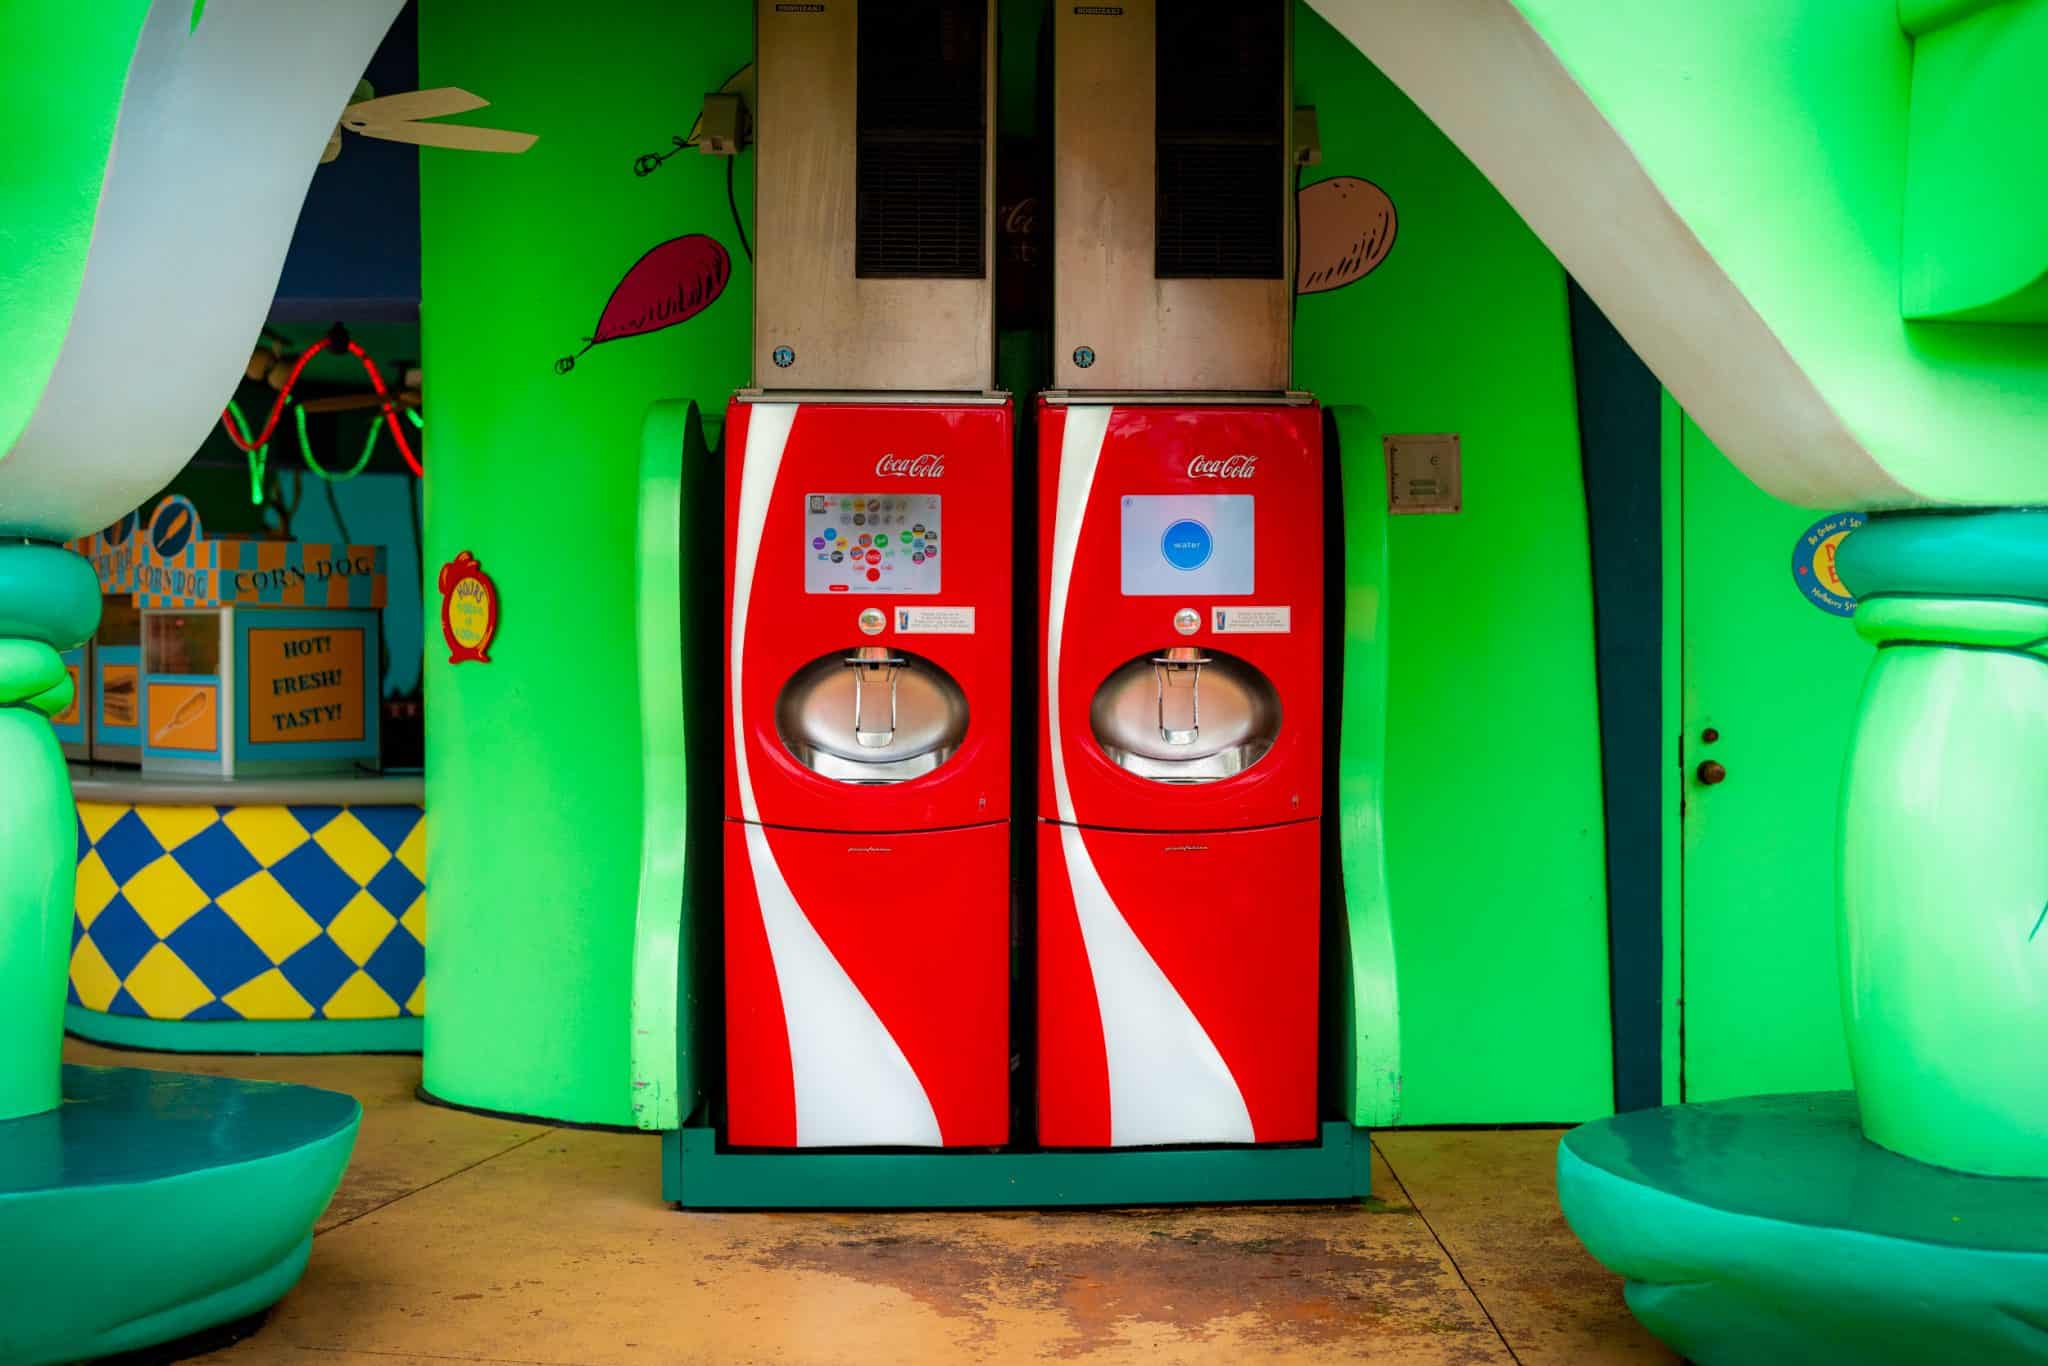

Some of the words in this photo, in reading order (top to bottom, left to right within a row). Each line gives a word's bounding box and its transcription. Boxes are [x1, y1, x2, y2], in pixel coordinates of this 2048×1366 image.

[875, 453, 945, 478] Coca-Cola
[1187, 454, 1258, 478] Coca-Cola
[1173, 541, 1201, 549] water
[137, 562, 172, 588] CORN
[177, 568, 207, 598] DOG
[234, 564, 305, 592] CORN
[316, 556, 371, 581] DOG
[283, 635, 332, 659] HOT!
[272, 668, 342, 696] FRESH!
[272, 703, 342, 731] TASTY!
